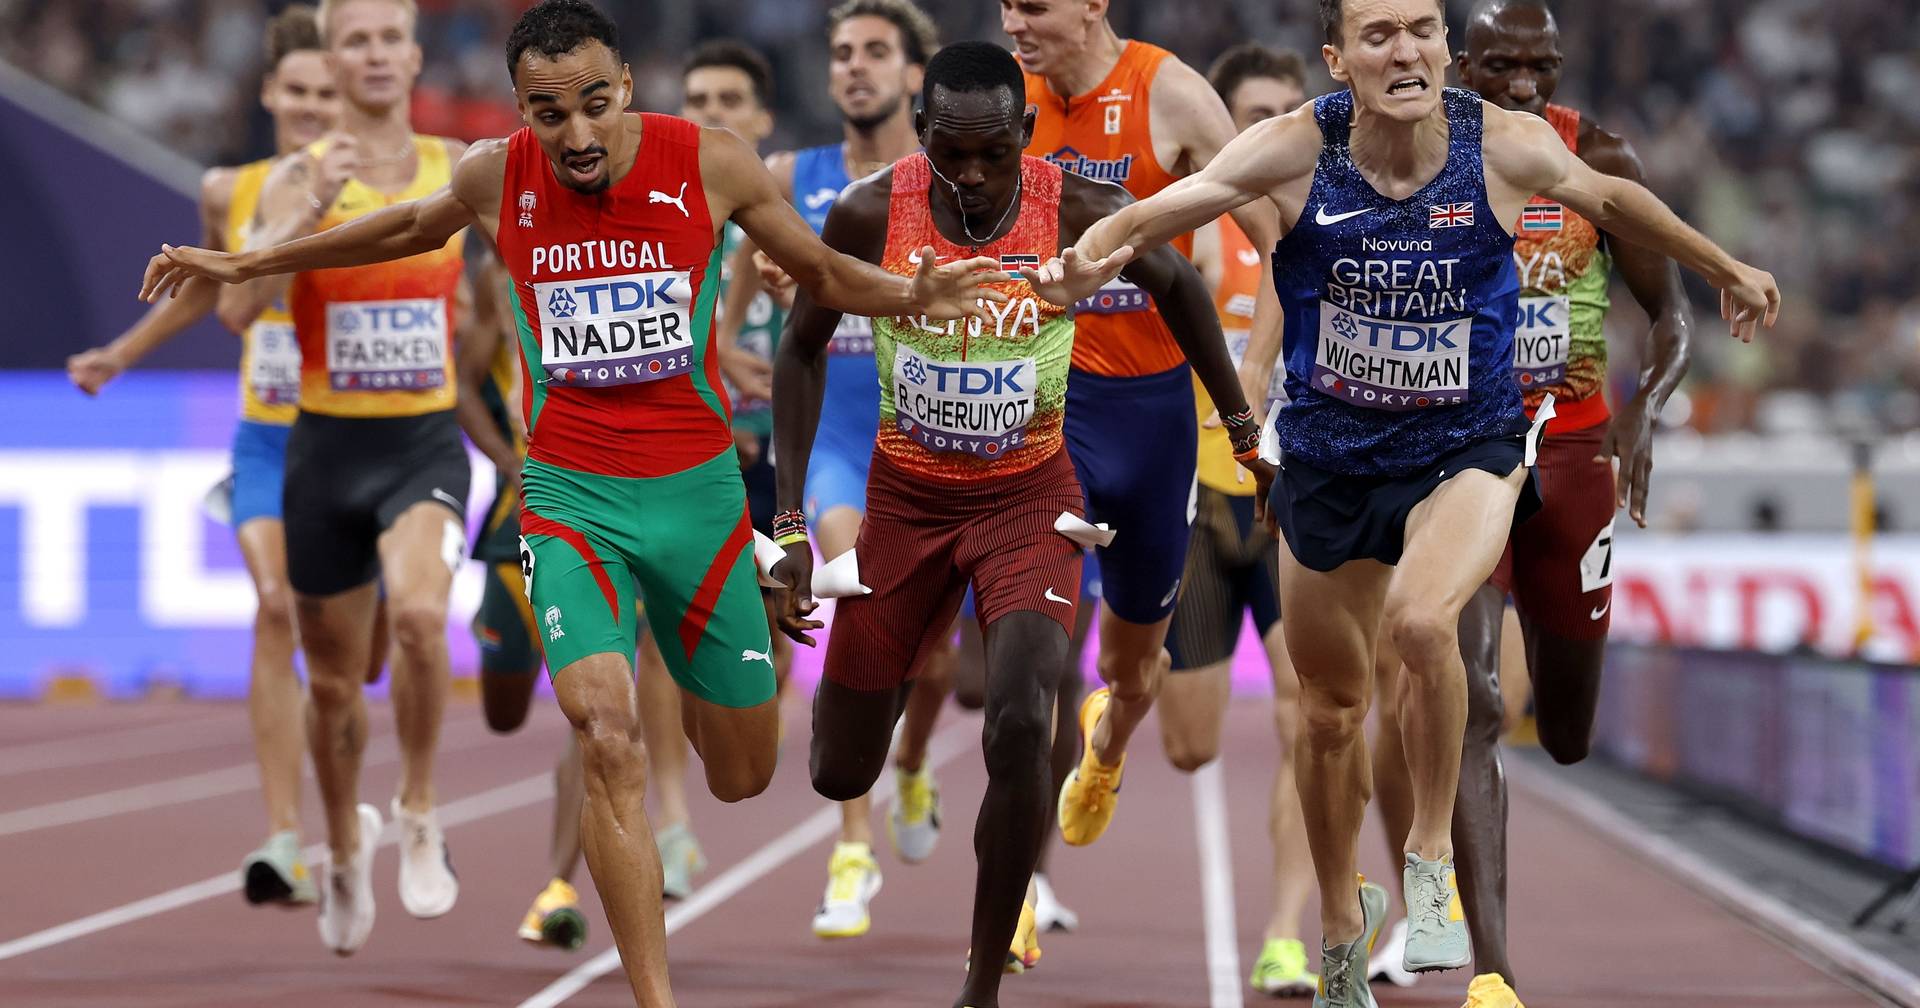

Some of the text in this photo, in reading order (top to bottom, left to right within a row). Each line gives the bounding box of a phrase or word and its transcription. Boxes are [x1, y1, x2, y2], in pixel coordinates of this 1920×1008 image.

[518, 218, 533, 228] FPA
[532, 240, 673, 275] PORTUGAL
[1362, 237, 1432, 251] Novuna
[1332, 258, 1460, 289] GREAT
[575, 277, 677, 315] TDK
[1327, 282, 1466, 318] BRITAIN
[363, 306, 437, 331] TDK
[552, 312, 682, 357] NADER
[896, 298, 1040, 337] NYA
[1359, 319, 1459, 353] TDK
[927, 363, 1025, 395] TDK
[1325, 338, 1460, 388] WIGHTMAN
[899, 384, 1029, 431] R. CHERUIYOT
[1599, 537, 1612, 579] 7
[1614, 567, 1920, 652] NDA
[549, 630, 565, 643] FPA
